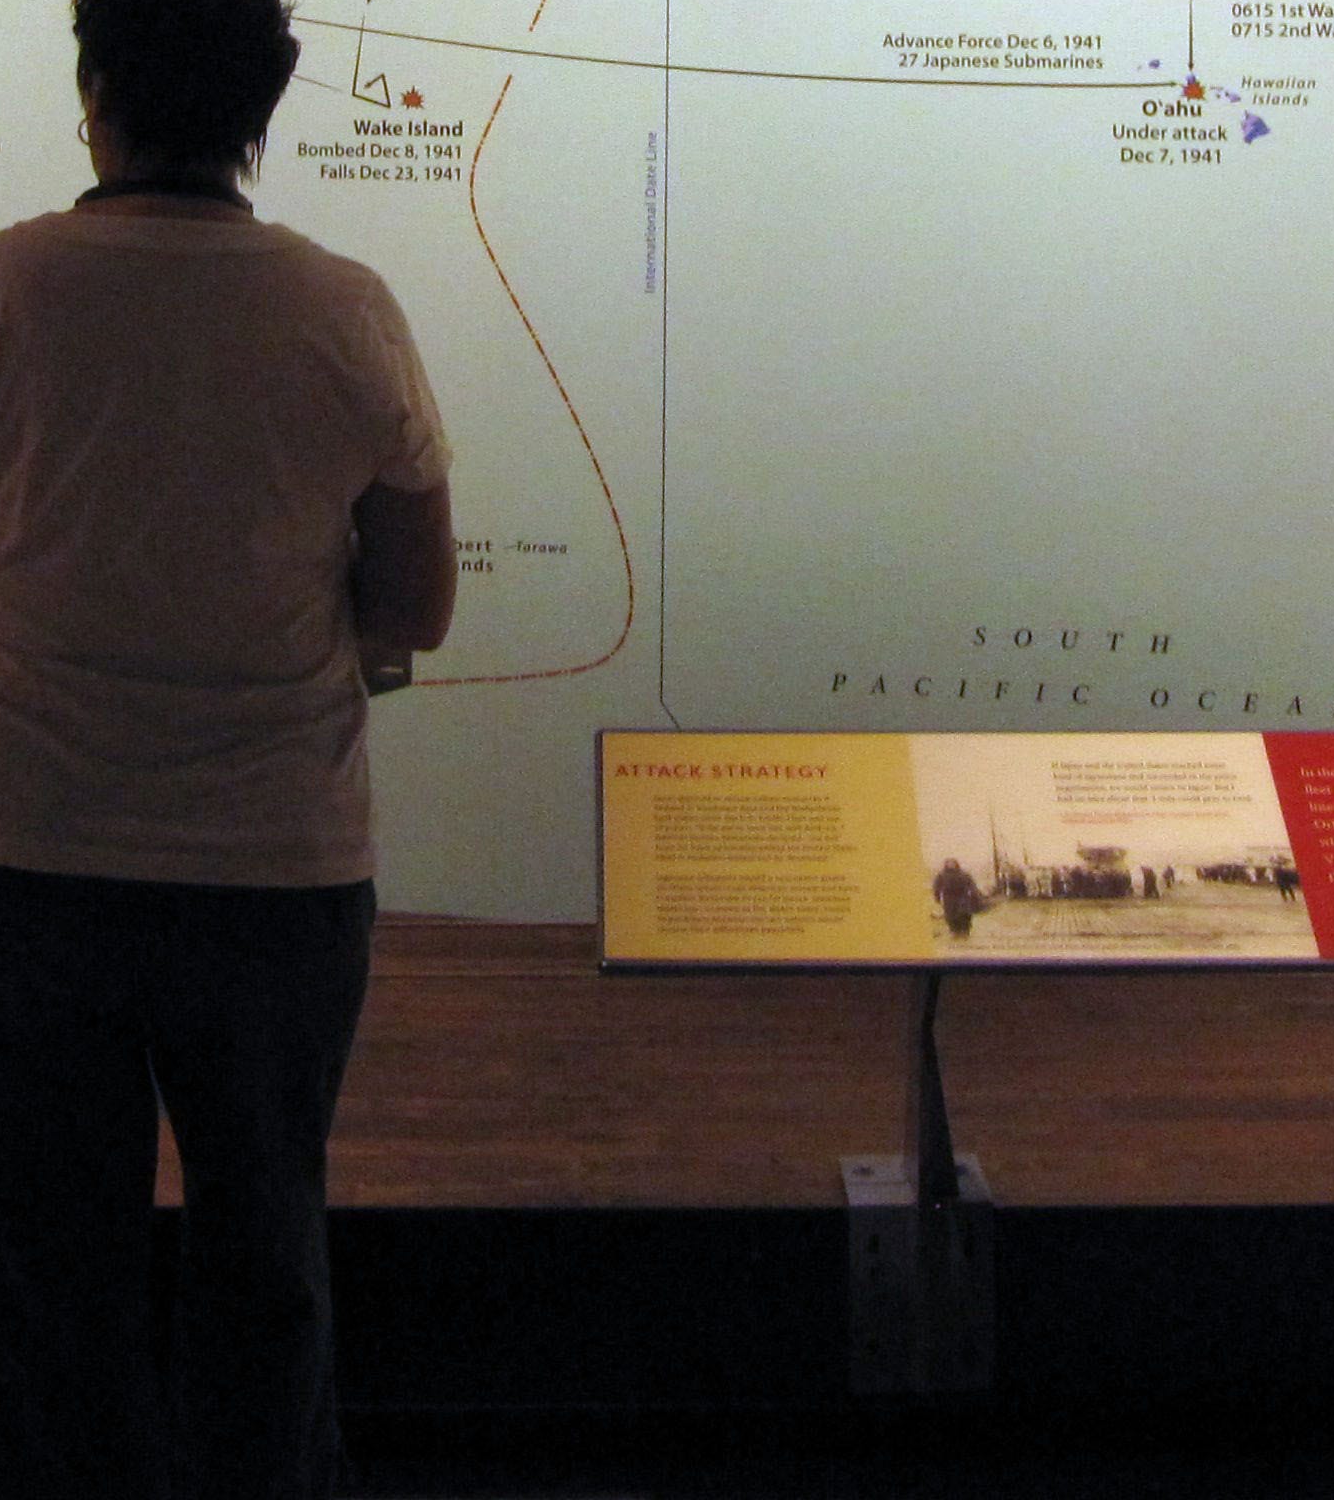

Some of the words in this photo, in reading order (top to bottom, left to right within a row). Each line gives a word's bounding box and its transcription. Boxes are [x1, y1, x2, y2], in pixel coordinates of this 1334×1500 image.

[1231, 2, 1274, 18] 0615
[1280, 3, 1304, 19] 1st
[1231, 22, 1274, 38] 0715
[1278, 21, 1312, 38] 2nd
[882, 32, 954, 49] Advance
[957, 33, 1003, 49] Force
[1006, 33, 1039, 50] Dec
[1042, 34, 1058, 51] 6,
[1063, 34, 1102, 50] 1941
[898, 52, 919, 68] 27
[922, 52, 1000, 72] Japanese
[1003, 52, 1104, 70] Submarines
[353, 119, 403, 137] Wake
[407, 119, 464, 138] Island
[1112, 123, 1168, 141] Under
[1171, 124, 1228, 142] attack
[297, 141, 366, 158] Bombed
[369, 142, 400, 159] Dec
[404, 143, 419, 161] 8,
[424, 144, 462, 160] 1941
[1120, 146, 1154, 164] Dec
[1160, 147, 1174, 166] 7,
[1181, 148, 1222, 165] 1941
[319, 163, 356, 180] Falls
[359, 164, 390, 181] Dec
[394, 165, 419, 183] 23,
[424, 166, 462, 182] 1941
[972, 626, 1171, 656] SOUTH
[831, 671, 1091, 707] PACIFIC
[615, 763, 701, 779] ATTACK
[711, 762, 828, 779] STRATEGY
